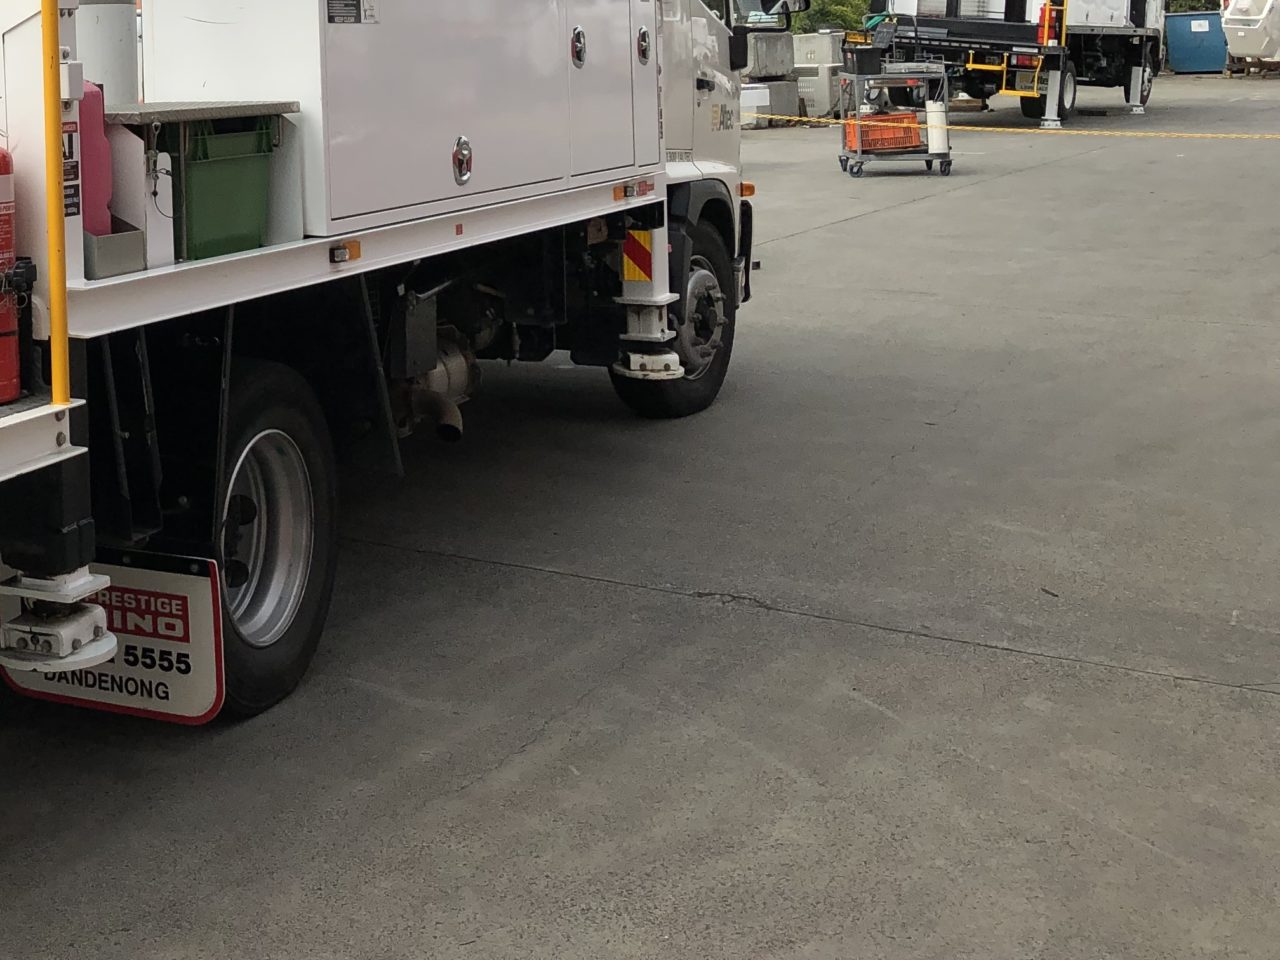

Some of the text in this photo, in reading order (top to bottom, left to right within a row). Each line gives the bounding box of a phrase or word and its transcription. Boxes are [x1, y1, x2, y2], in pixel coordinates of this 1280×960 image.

[720, 103, 734, 130] Altec
[113, 612, 185, 638] INO
[123, 644, 192, 675] 5555
[44, 669, 170, 701] DANDENONG
